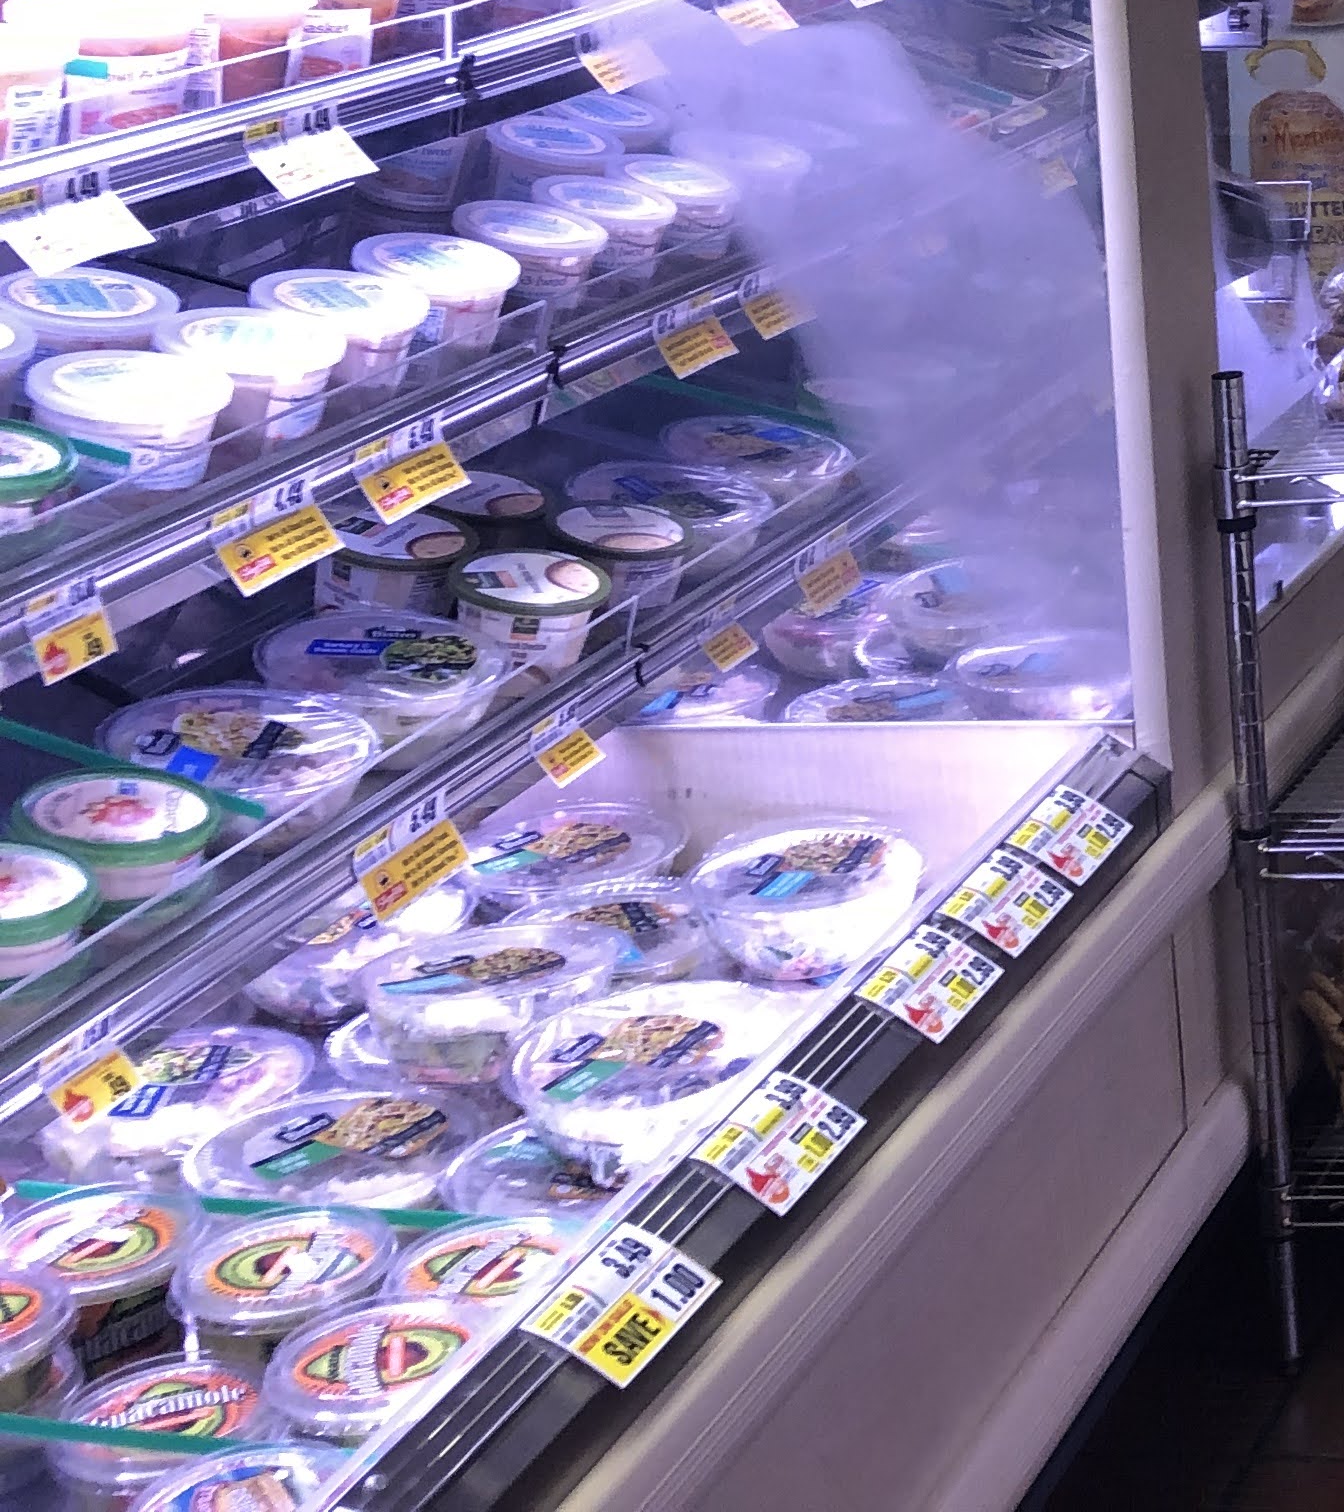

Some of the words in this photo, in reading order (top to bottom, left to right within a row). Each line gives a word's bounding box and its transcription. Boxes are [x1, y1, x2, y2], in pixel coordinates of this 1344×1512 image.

[600, 1237, 653, 1279] 3.49
[650, 1263, 705, 1313] 1.00
[602, 1312, 662, 1366] SAVE
